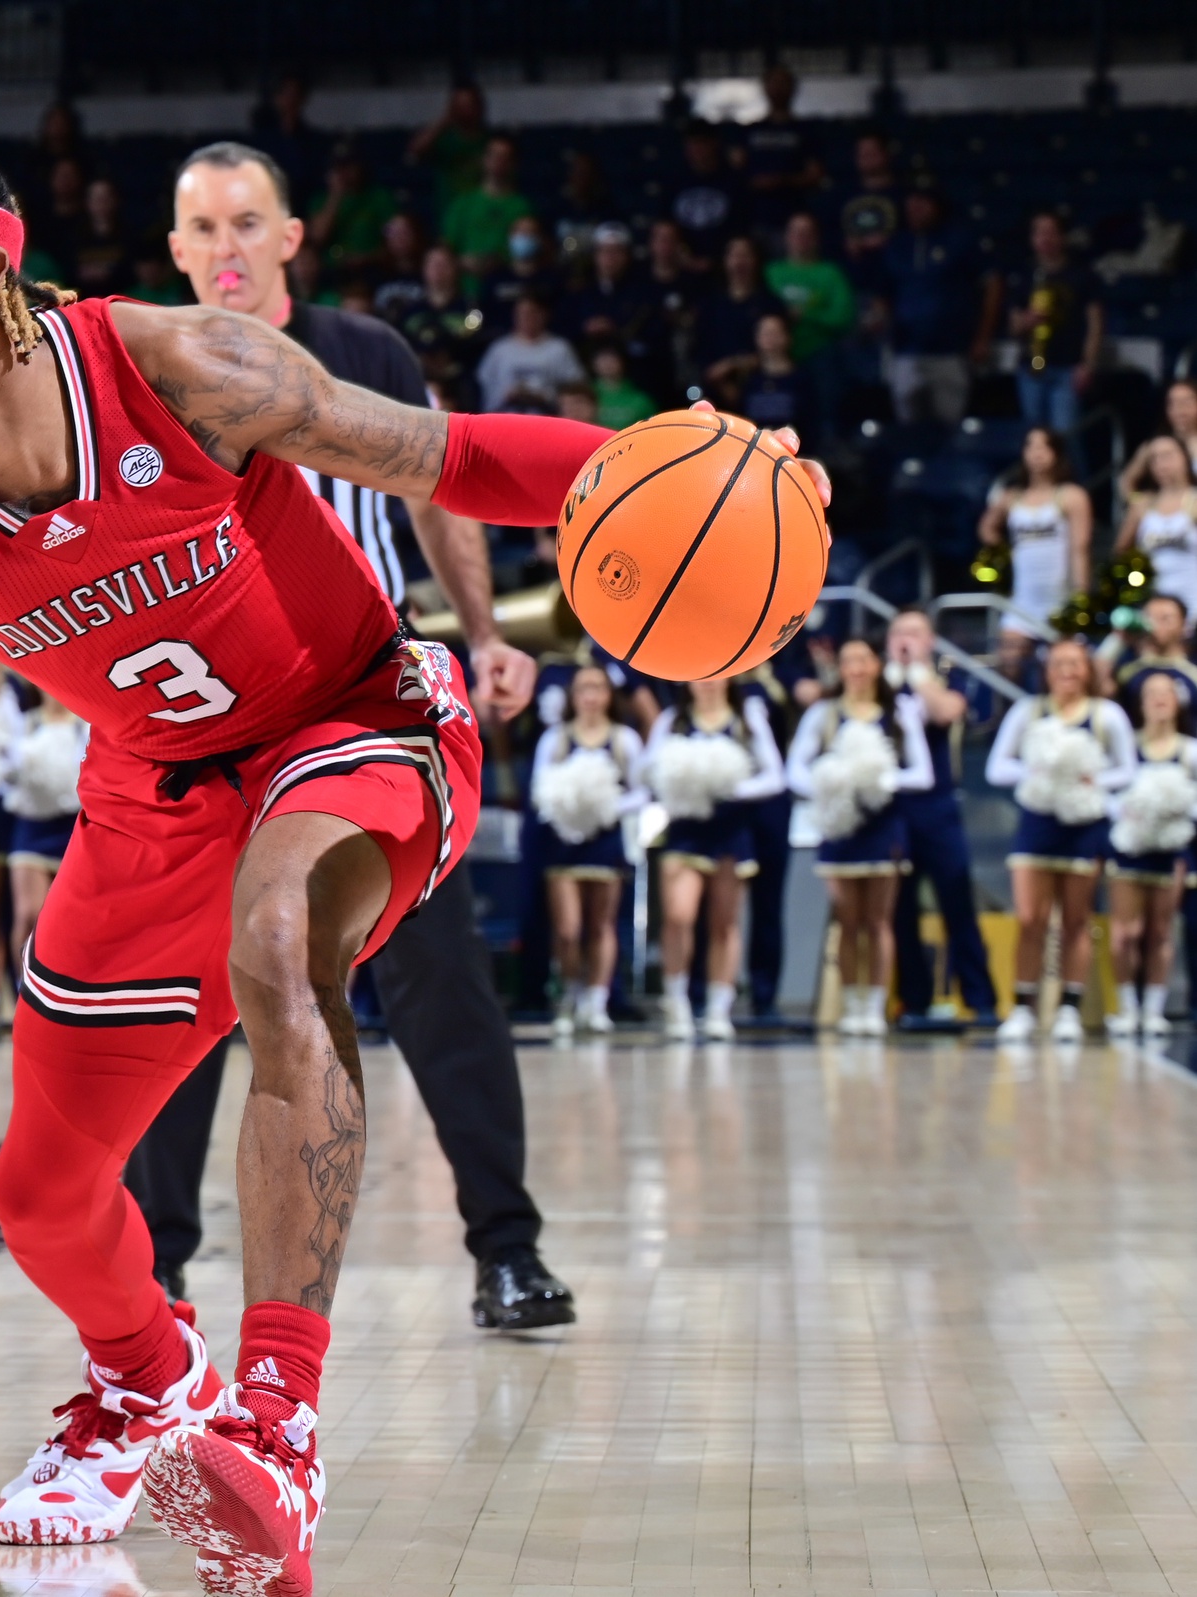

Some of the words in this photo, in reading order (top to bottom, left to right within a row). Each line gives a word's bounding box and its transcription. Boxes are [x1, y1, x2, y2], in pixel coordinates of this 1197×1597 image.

[42, 524, 86, 550] adidas
[105, 638, 240, 724] 3
[245, 1372, 286, 1387] adidas
